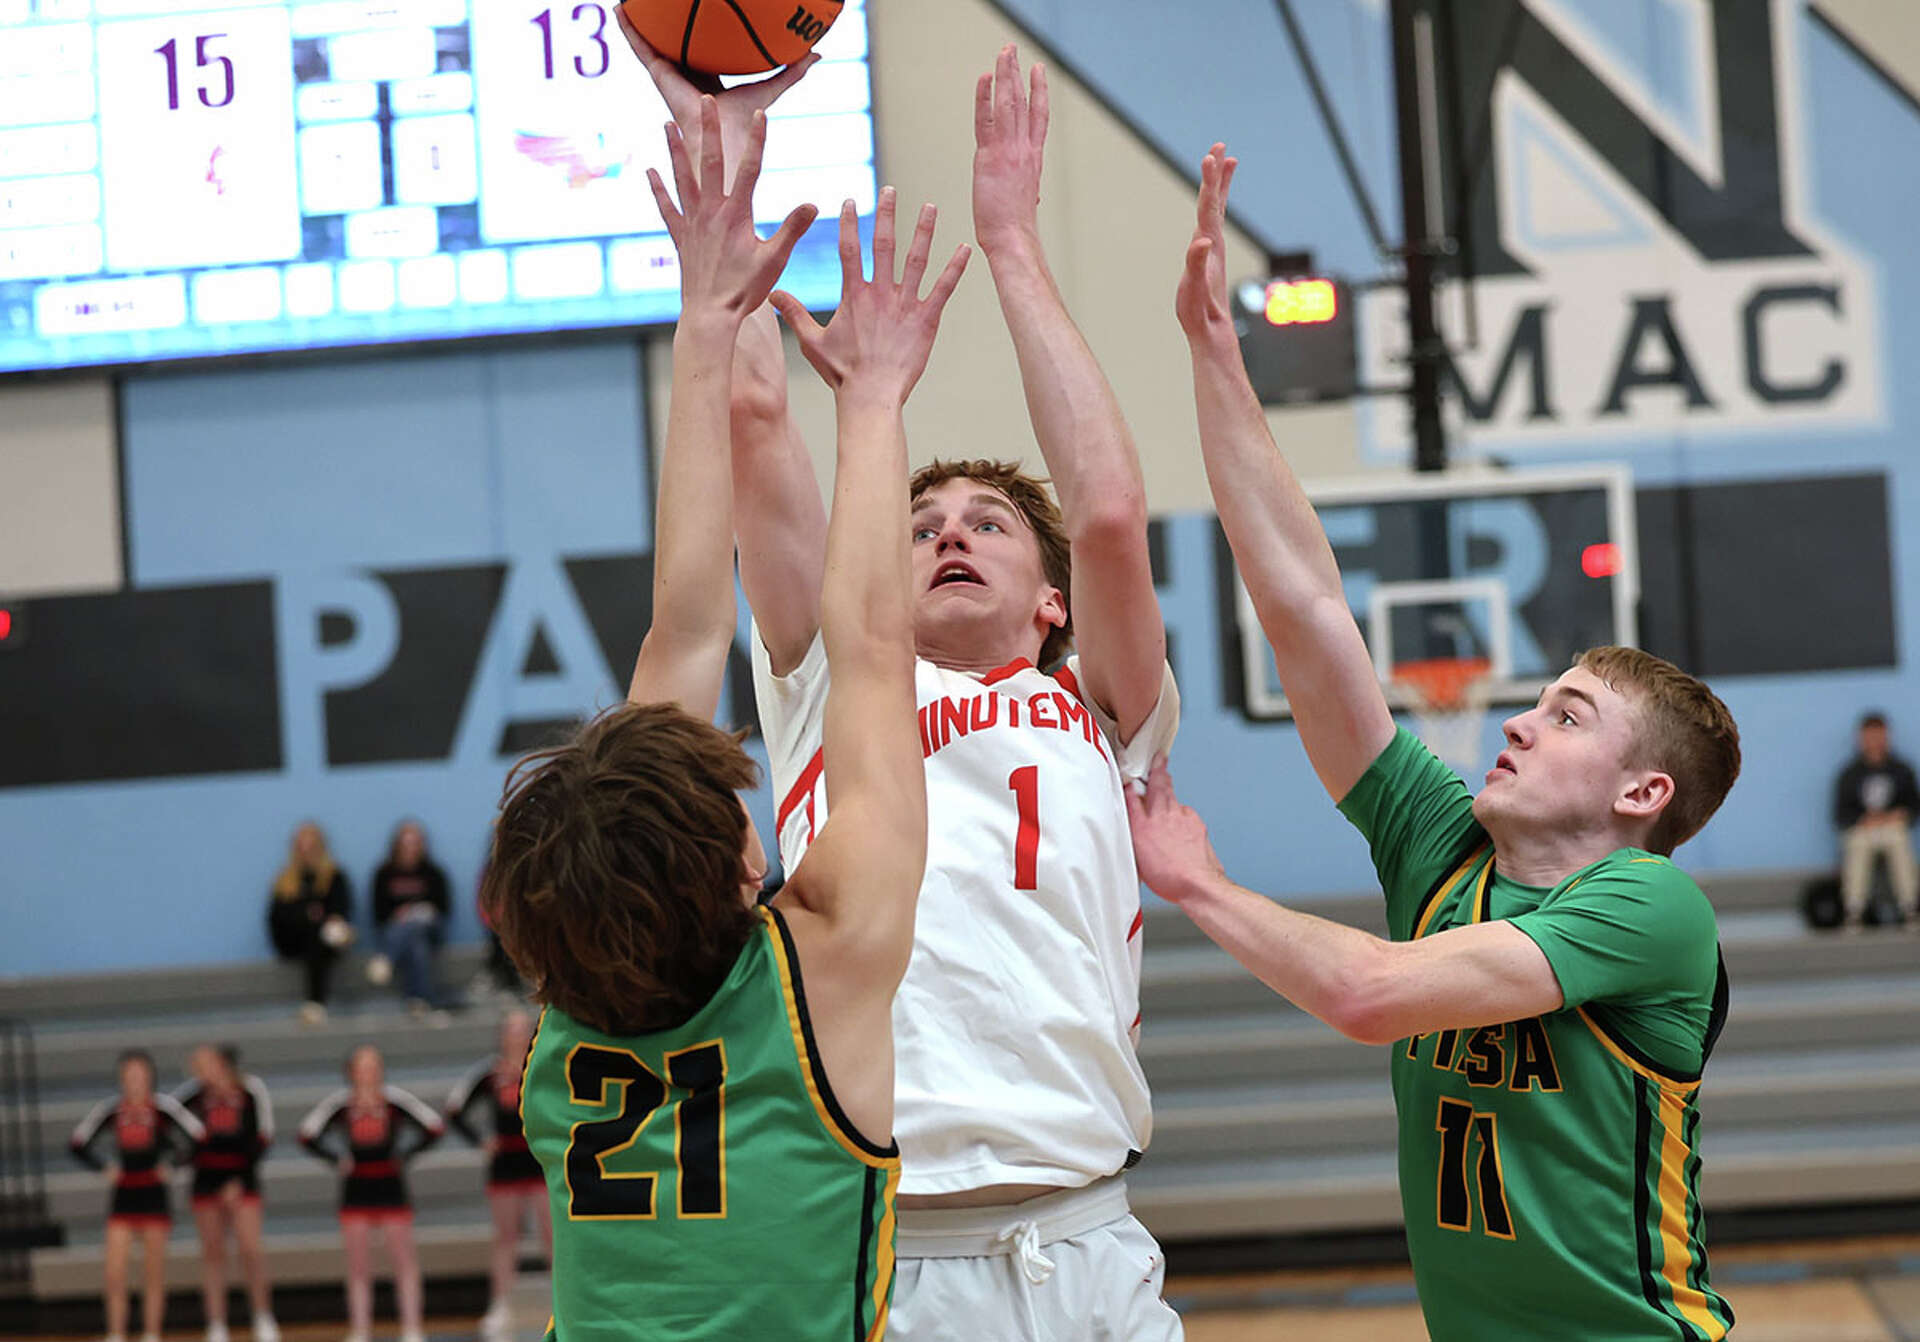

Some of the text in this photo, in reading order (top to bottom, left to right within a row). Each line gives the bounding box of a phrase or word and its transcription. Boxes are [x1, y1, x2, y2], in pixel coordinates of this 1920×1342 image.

[153, 33, 235, 110] 15
[530, 3, 610, 80] 13
[918, 690, 1109, 764] INUTEM
[1008, 764, 1040, 890] 1
[564, 1038, 728, 1221] 21
[1435, 1095, 1517, 1241] 11
